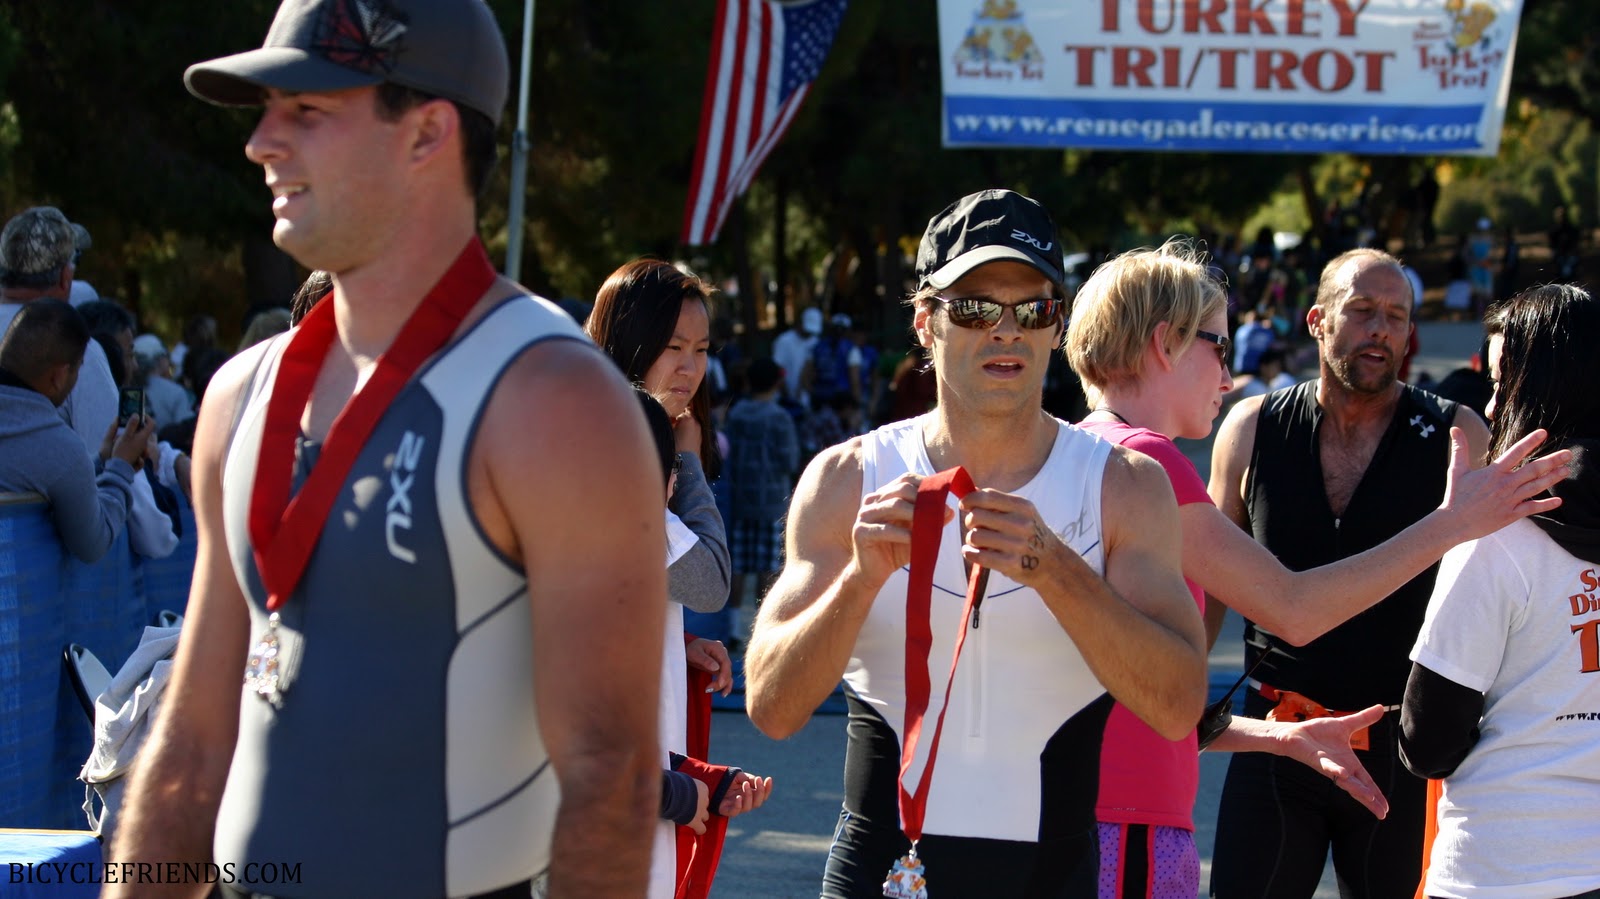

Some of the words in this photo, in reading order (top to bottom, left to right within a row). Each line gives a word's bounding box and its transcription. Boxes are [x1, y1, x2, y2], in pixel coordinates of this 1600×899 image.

[1098, 0, 1368, 37] TURKEY
[1065, 44, 1396, 93] TRI/TROT
[1010, 228, 1053, 251] 2XU
[385, 429, 426, 565] 2XU
